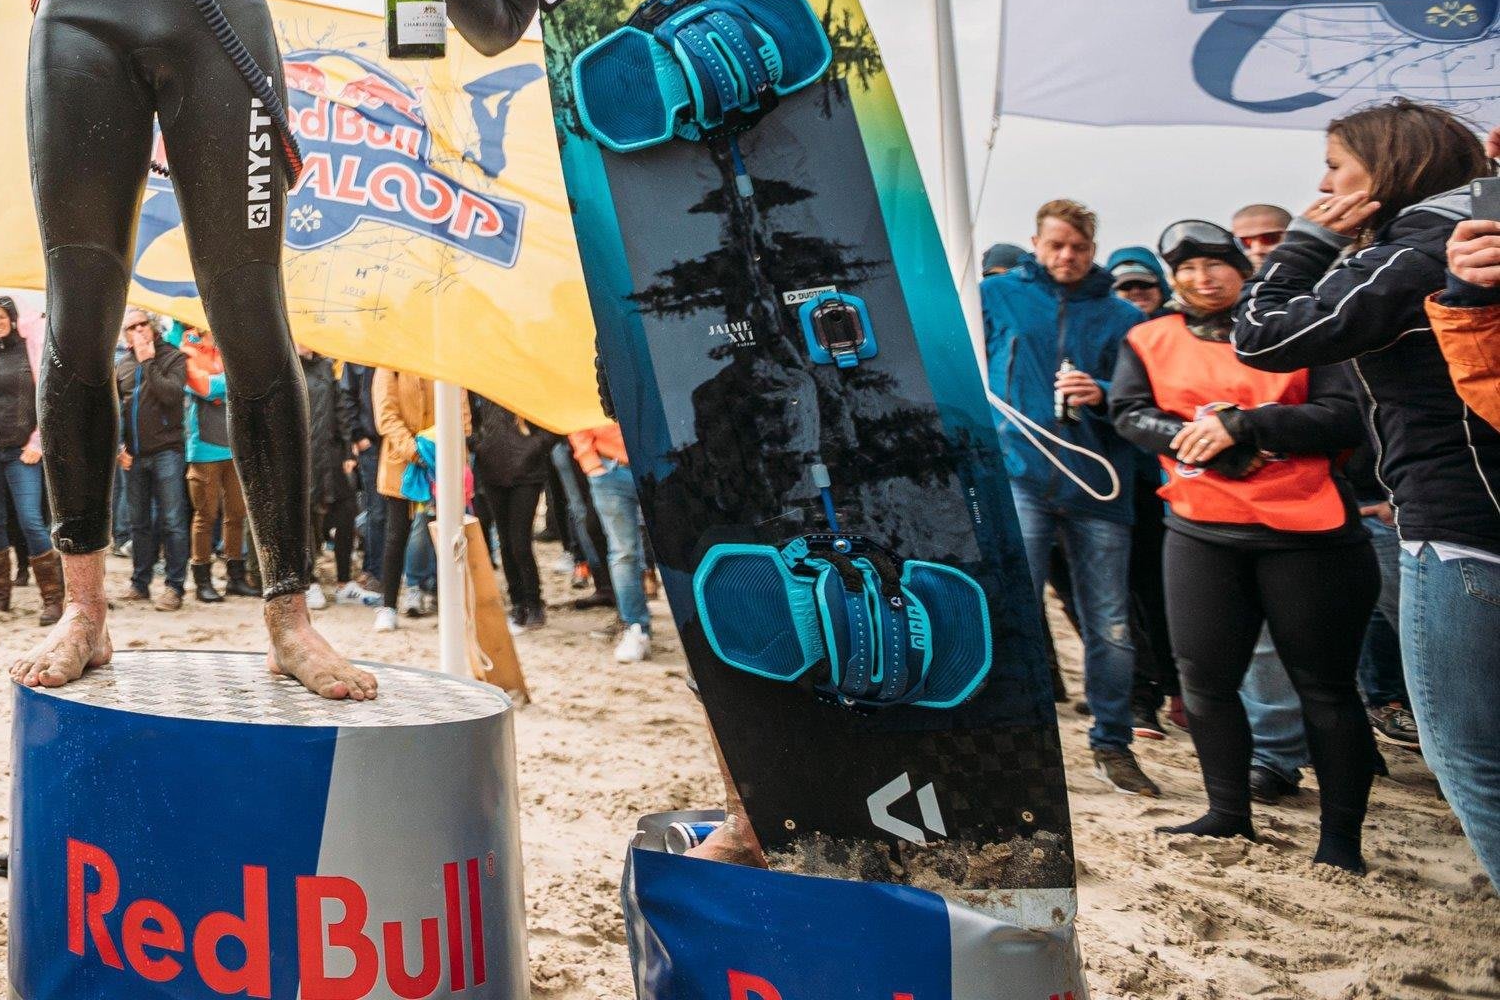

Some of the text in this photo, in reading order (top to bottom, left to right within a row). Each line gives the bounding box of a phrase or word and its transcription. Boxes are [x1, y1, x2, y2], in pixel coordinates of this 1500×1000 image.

[248, 76, 272, 200] MYST
[288, 94, 424, 158] ed Bull
[288, 153, 503, 239] ALOOP
[798, 289, 833, 300] DUOT
[67, 837, 486, 1000] Red Bull
